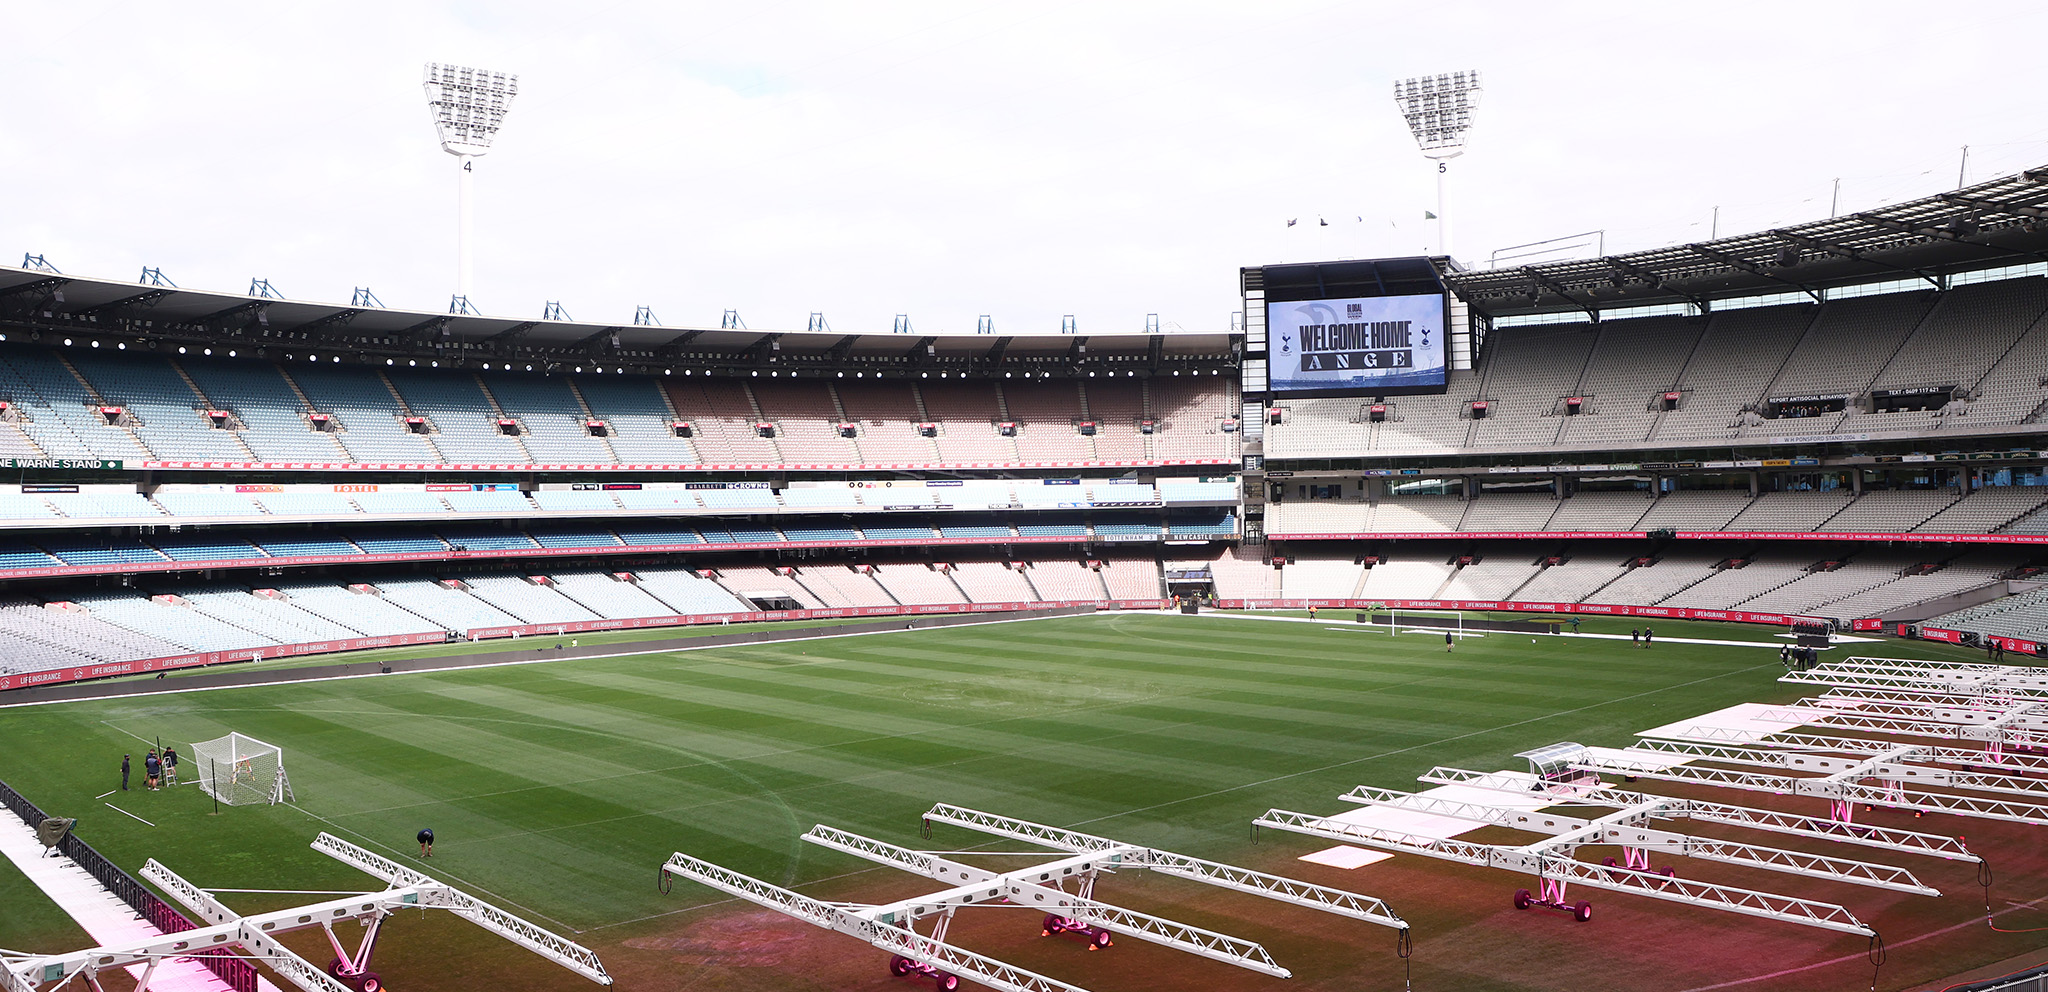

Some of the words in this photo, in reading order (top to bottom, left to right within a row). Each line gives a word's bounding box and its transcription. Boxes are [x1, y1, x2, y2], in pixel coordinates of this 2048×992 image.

[464, 161, 472, 173] 4
[1439, 163, 1446, 173] 5
[1300, 322, 1370, 352] WELCOME
[1371, 320, 1412, 348] HOME
[1308, 352, 1405, 369] ANGE
[16, 459, 60, 468] WARNE
[63, 460, 102, 468] STAND
[1928, 630, 1948, 639] INSURANCE
[173, 656, 200, 665] INSURANCE
[92, 667, 102, 675] LIFE
[103, 664, 131, 674] INSURANCE
[20, 676, 31, 684] LIFE
[32, 673, 61, 683] INSURANCE
